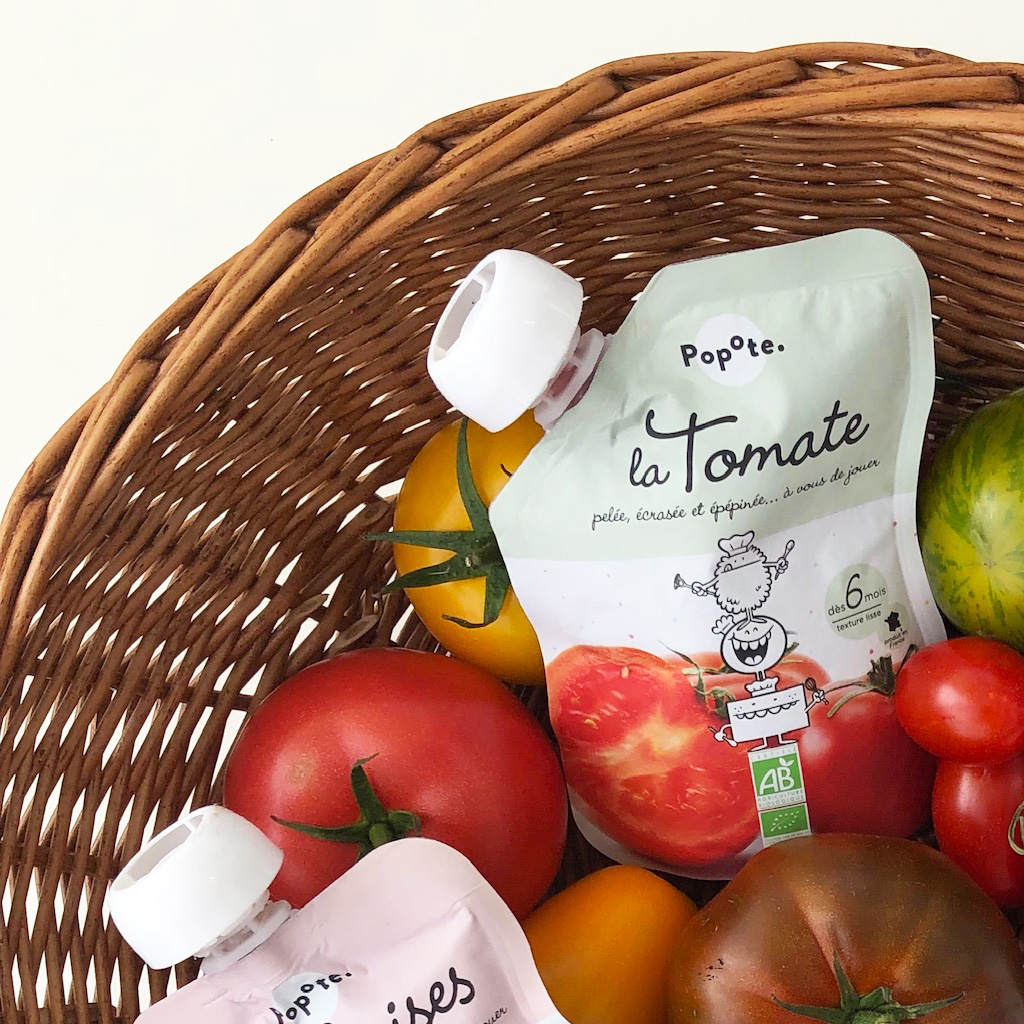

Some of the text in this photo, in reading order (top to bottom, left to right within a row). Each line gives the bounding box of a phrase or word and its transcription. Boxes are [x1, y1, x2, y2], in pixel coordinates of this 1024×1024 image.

[680, 335, 785, 371] Popote.
[629, 400, 870, 493] la Tomate
[591, 507, 630, 531] pelée,
[636, 505, 687, 521] écrasée
[691, 502, 705, 517] et
[783, 487, 794, 499] à
[796, 478, 827, 495] vous
[829, 467, 845, 482] de
[845, 457, 881, 485] jouer
[828, 573, 887, 616] dès 6 mois
[837, 610, 882, 632] texture lisse
[759, 766, 795, 795] AB
